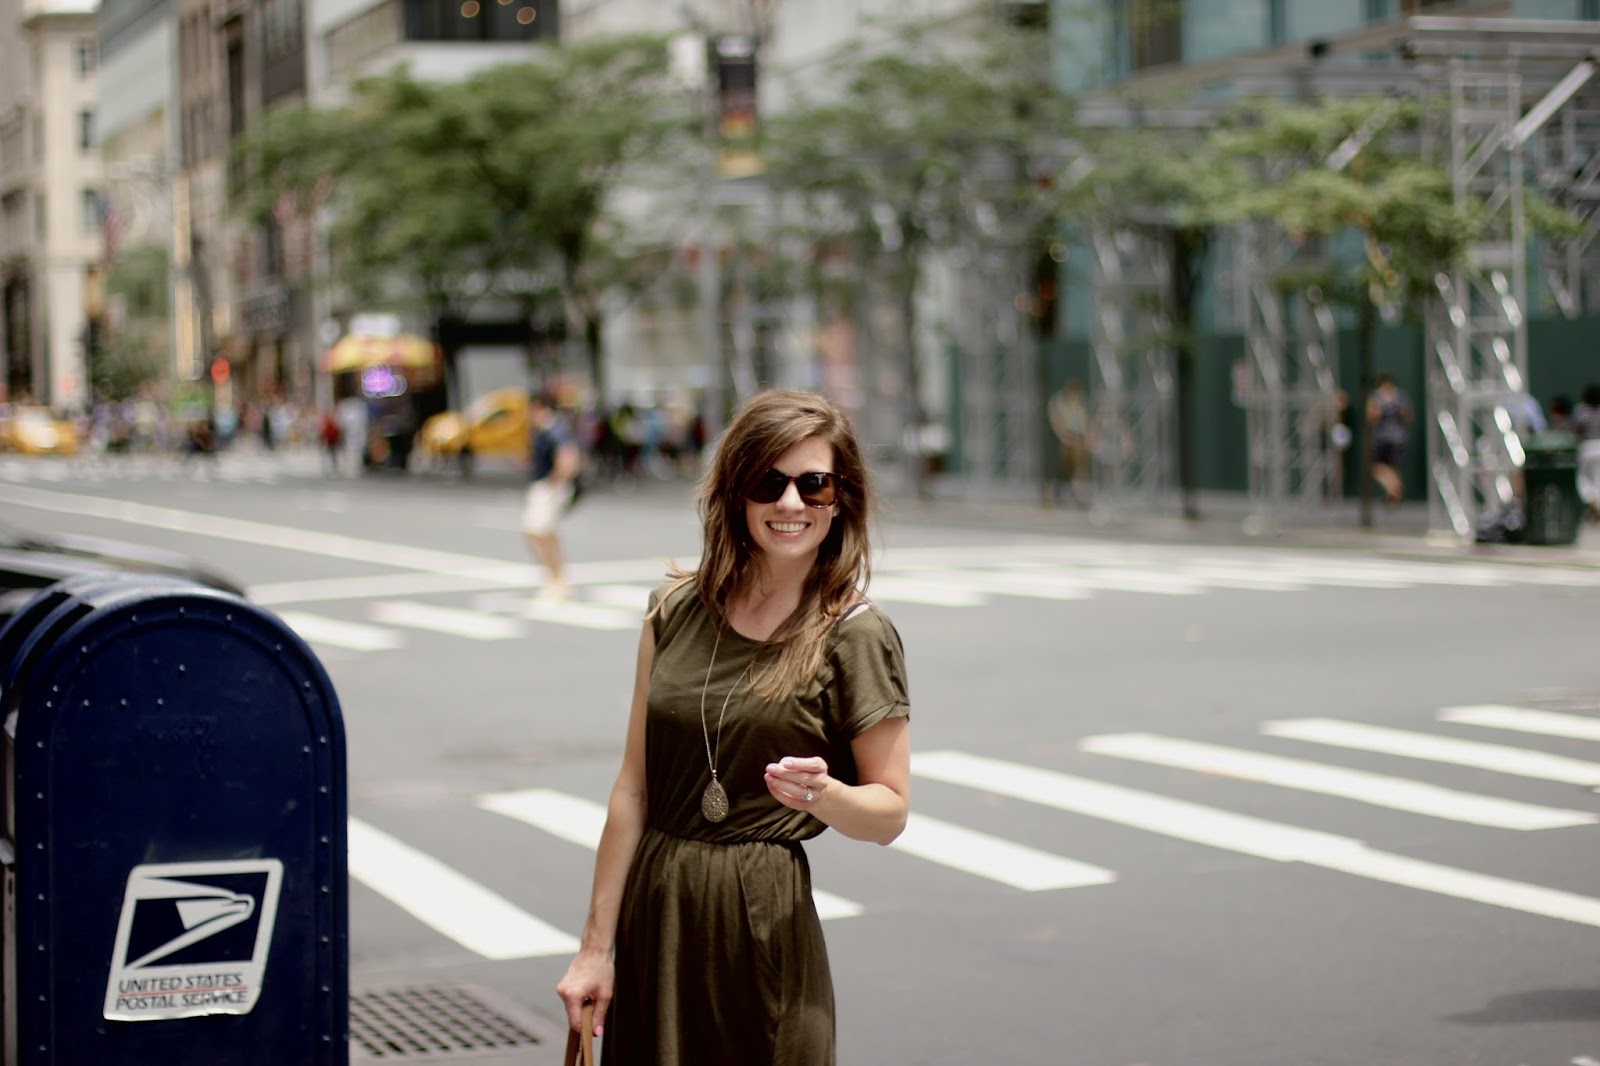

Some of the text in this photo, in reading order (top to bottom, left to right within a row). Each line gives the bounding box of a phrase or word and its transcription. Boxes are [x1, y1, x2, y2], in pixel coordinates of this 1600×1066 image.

[119, 973, 243, 993] UNITED STATES
[115, 990, 248, 1010] POSTAL SERVICE
